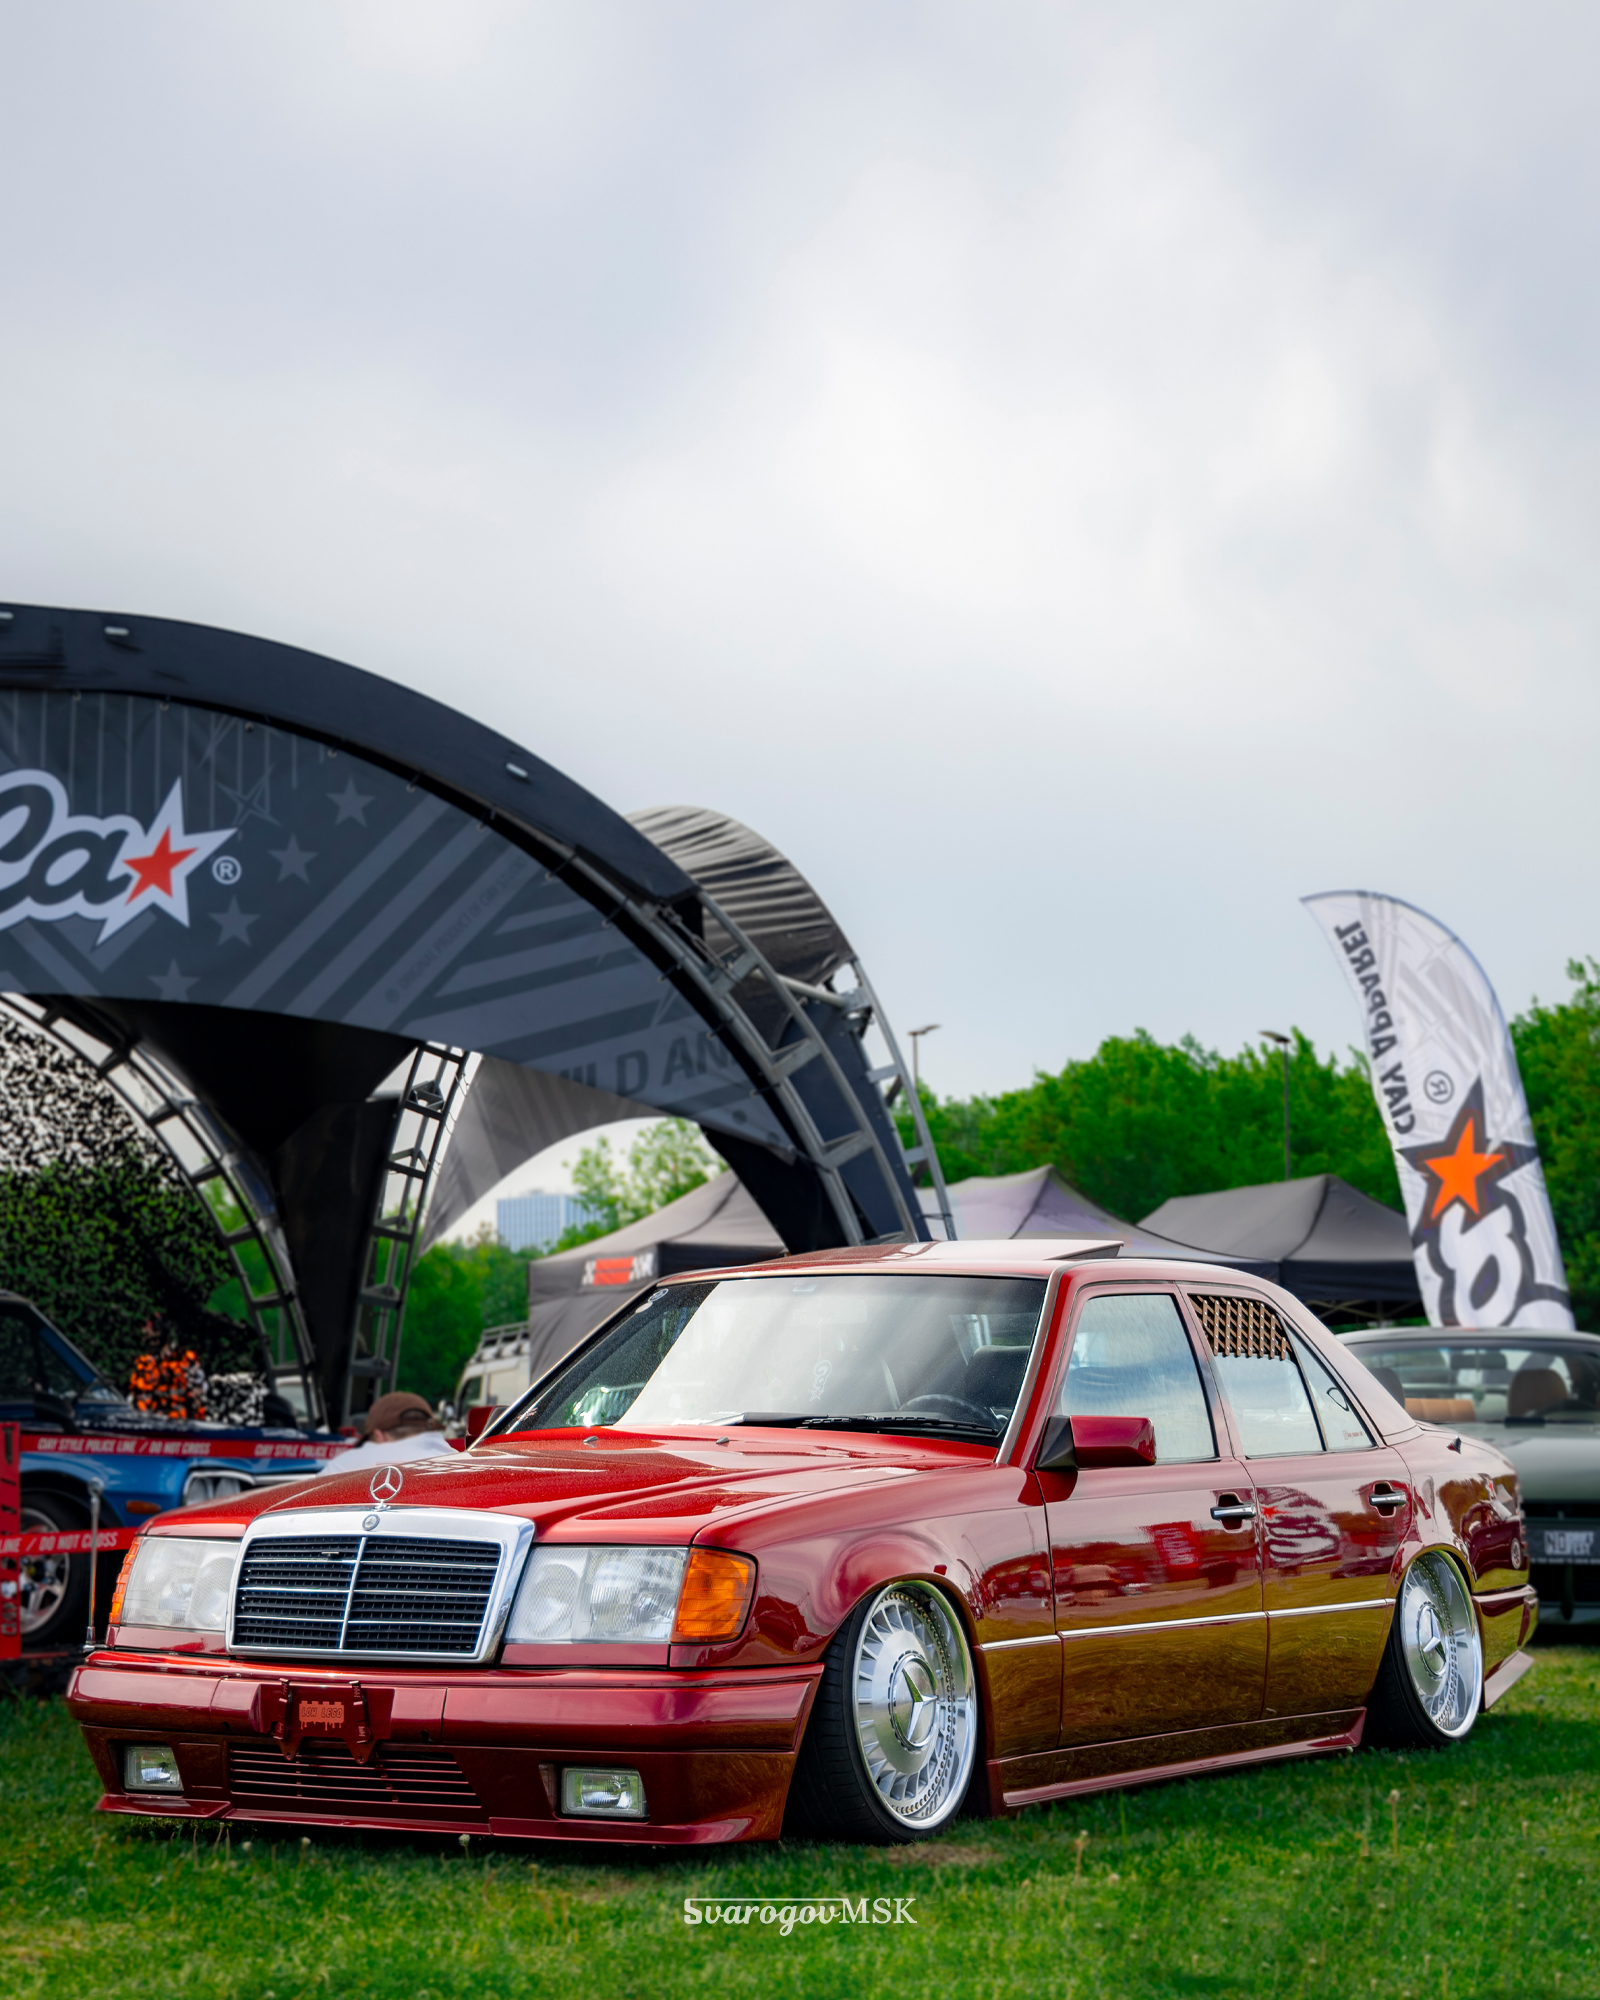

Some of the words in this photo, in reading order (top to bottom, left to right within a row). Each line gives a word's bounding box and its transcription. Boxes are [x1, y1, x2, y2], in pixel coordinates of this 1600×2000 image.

[432, 912, 473, 954] PRODUCT
[661, 1031, 738, 1087] AN
[58, 1438, 85, 1452] STYLE
[84, 1438, 116, 1453] POLICE
[116, 1439, 137, 1453] LINE
[149, 1440, 163, 1454] DO
[163, 1440, 182, 1455] NOT
[181, 1441, 211, 1456] CROSS
[274, 1444, 299, 1457] STYLE
[300, 1444, 328, 1458] POLICE
[39, 1535, 56, 1552] DO
[57, 1533, 81, 1551] NOT
[81, 1531, 119, 1549] COSS
[302, 1706, 318, 1718] LOW
[321, 1707, 343, 1719] LEGO
